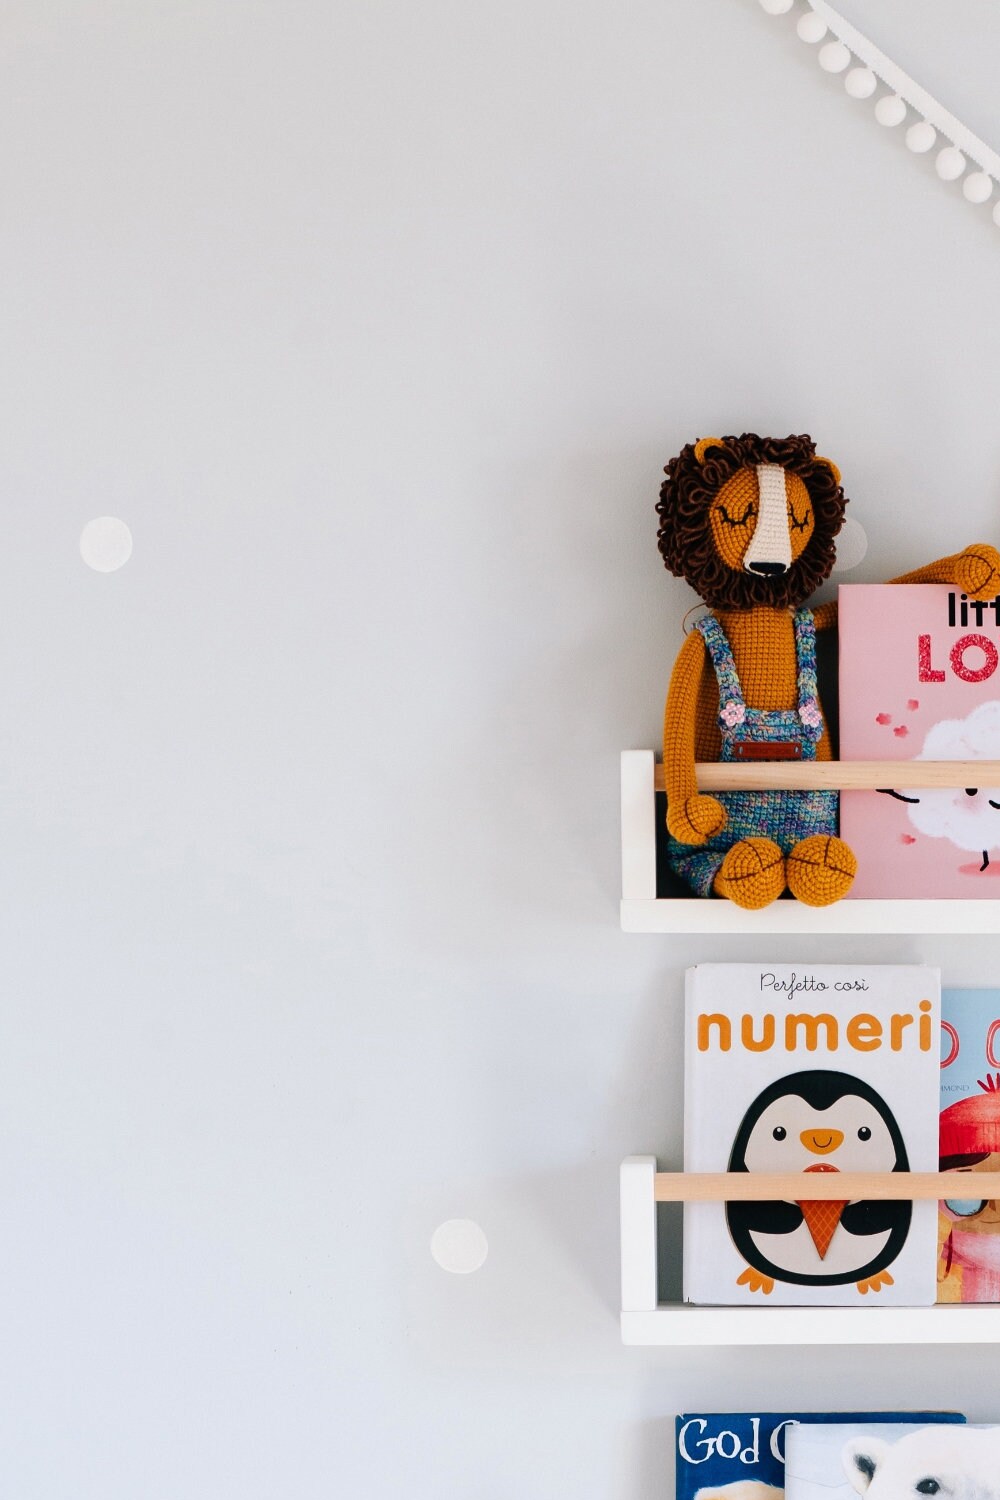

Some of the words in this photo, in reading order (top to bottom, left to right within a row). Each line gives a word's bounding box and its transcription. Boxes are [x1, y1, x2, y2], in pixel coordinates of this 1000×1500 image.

[761, 973, 829, 1000] Perfetto
[834, 979, 869, 991] così
[697, 1000, 932, 1051] numeri
[940, 1084, 970, 1092] MOND
[679, 1418, 760, 1464] God
